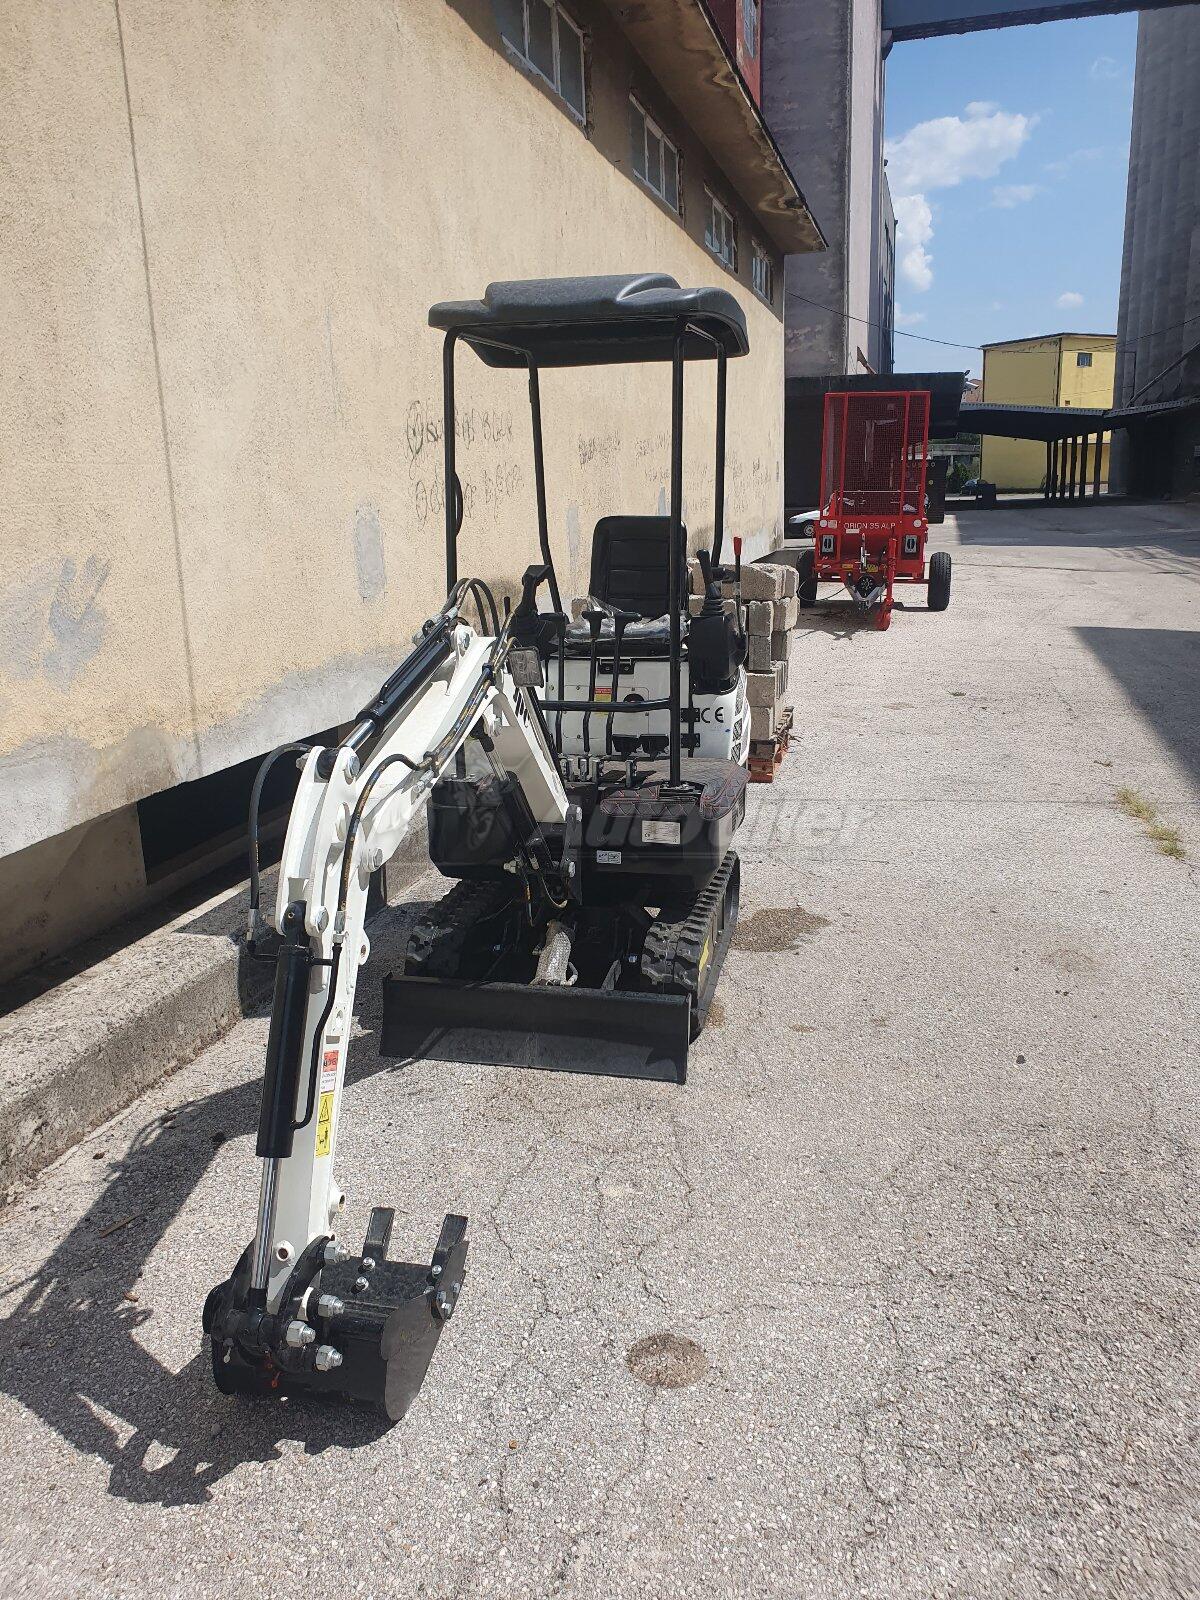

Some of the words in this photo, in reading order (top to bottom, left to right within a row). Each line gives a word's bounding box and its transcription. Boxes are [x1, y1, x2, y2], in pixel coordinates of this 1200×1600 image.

[843, 522, 868, 530] ORION
[869, 522, 880, 530] 35
[700, 706, 724, 724] CE
